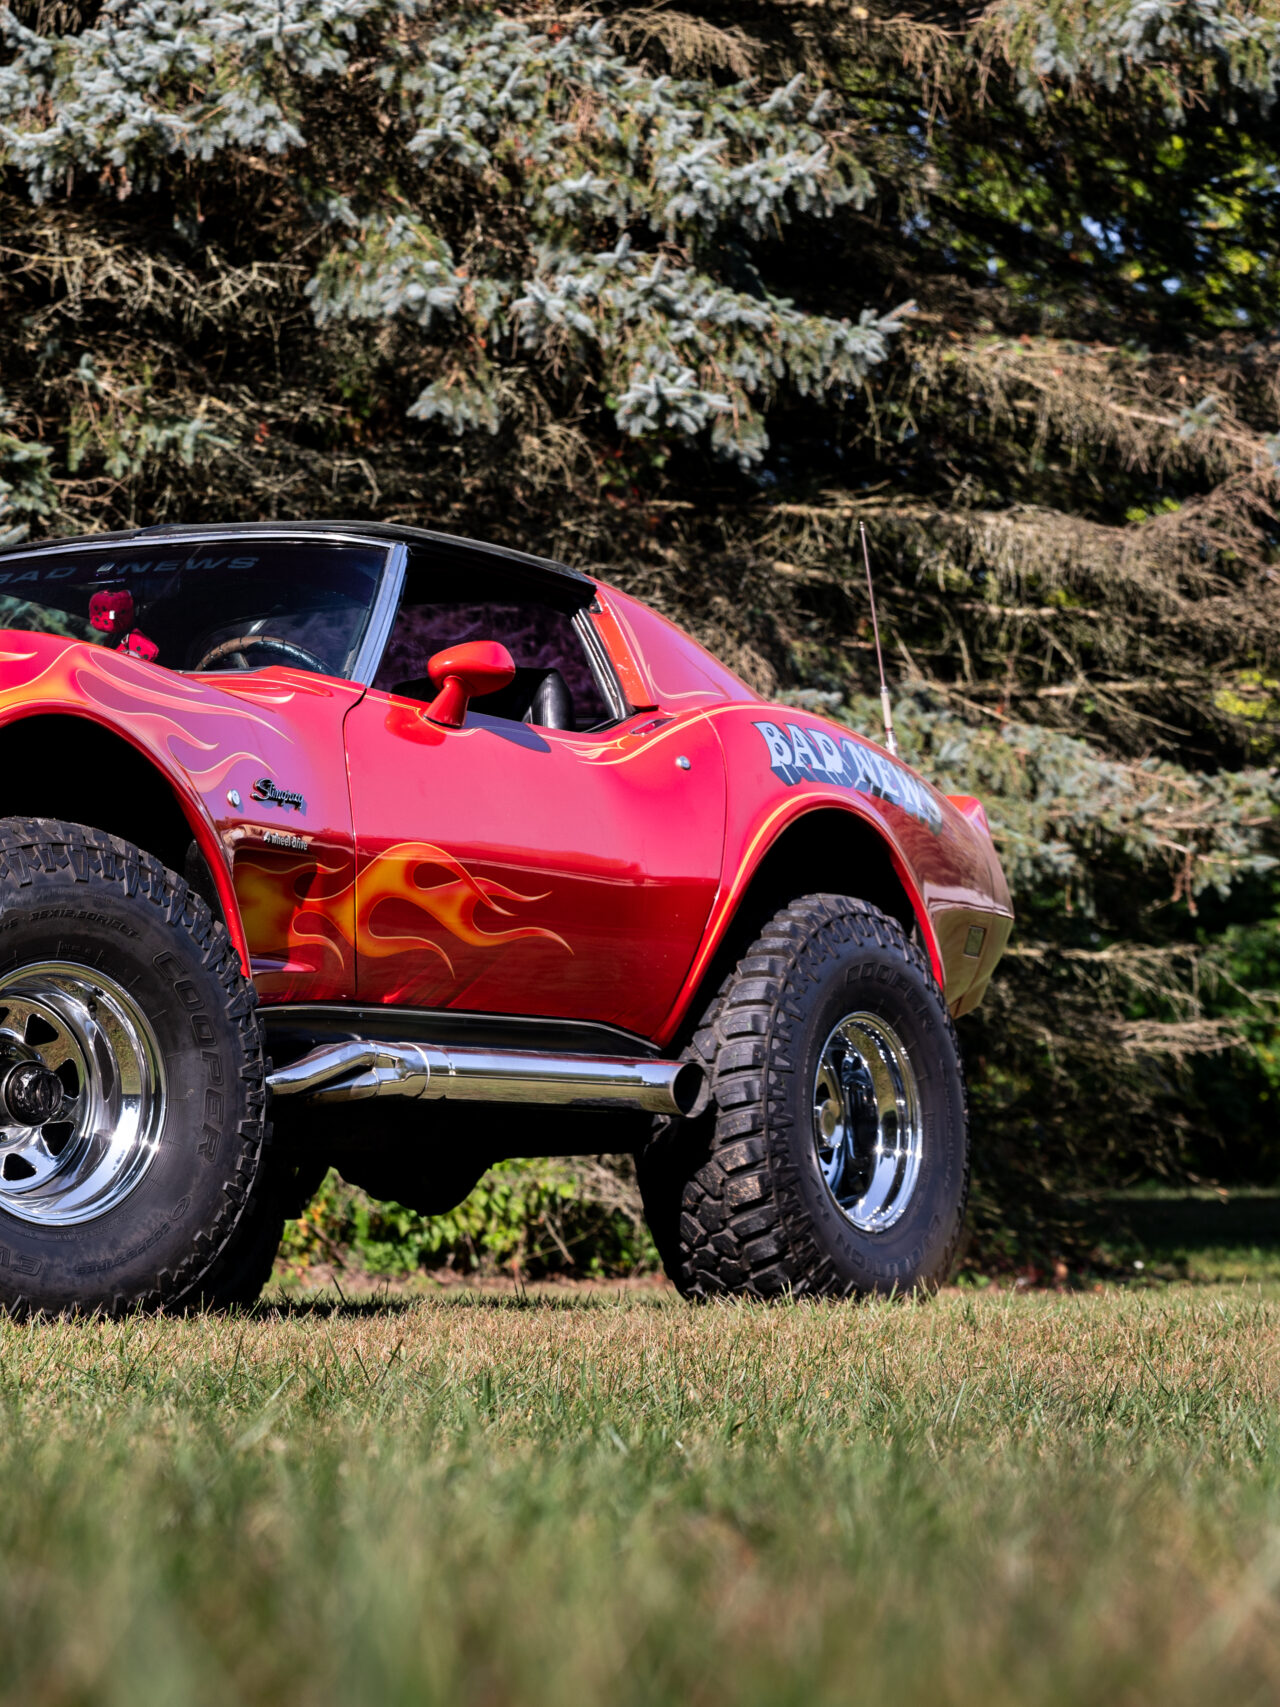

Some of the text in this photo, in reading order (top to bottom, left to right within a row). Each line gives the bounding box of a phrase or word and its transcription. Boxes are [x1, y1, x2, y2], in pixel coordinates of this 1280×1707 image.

[117, 556, 261, 575] NEWS
[751, 721, 852, 785] BAD
[263, 831, 308, 851] 4 wheel drive
[152, 950, 225, 1163] COOPER
